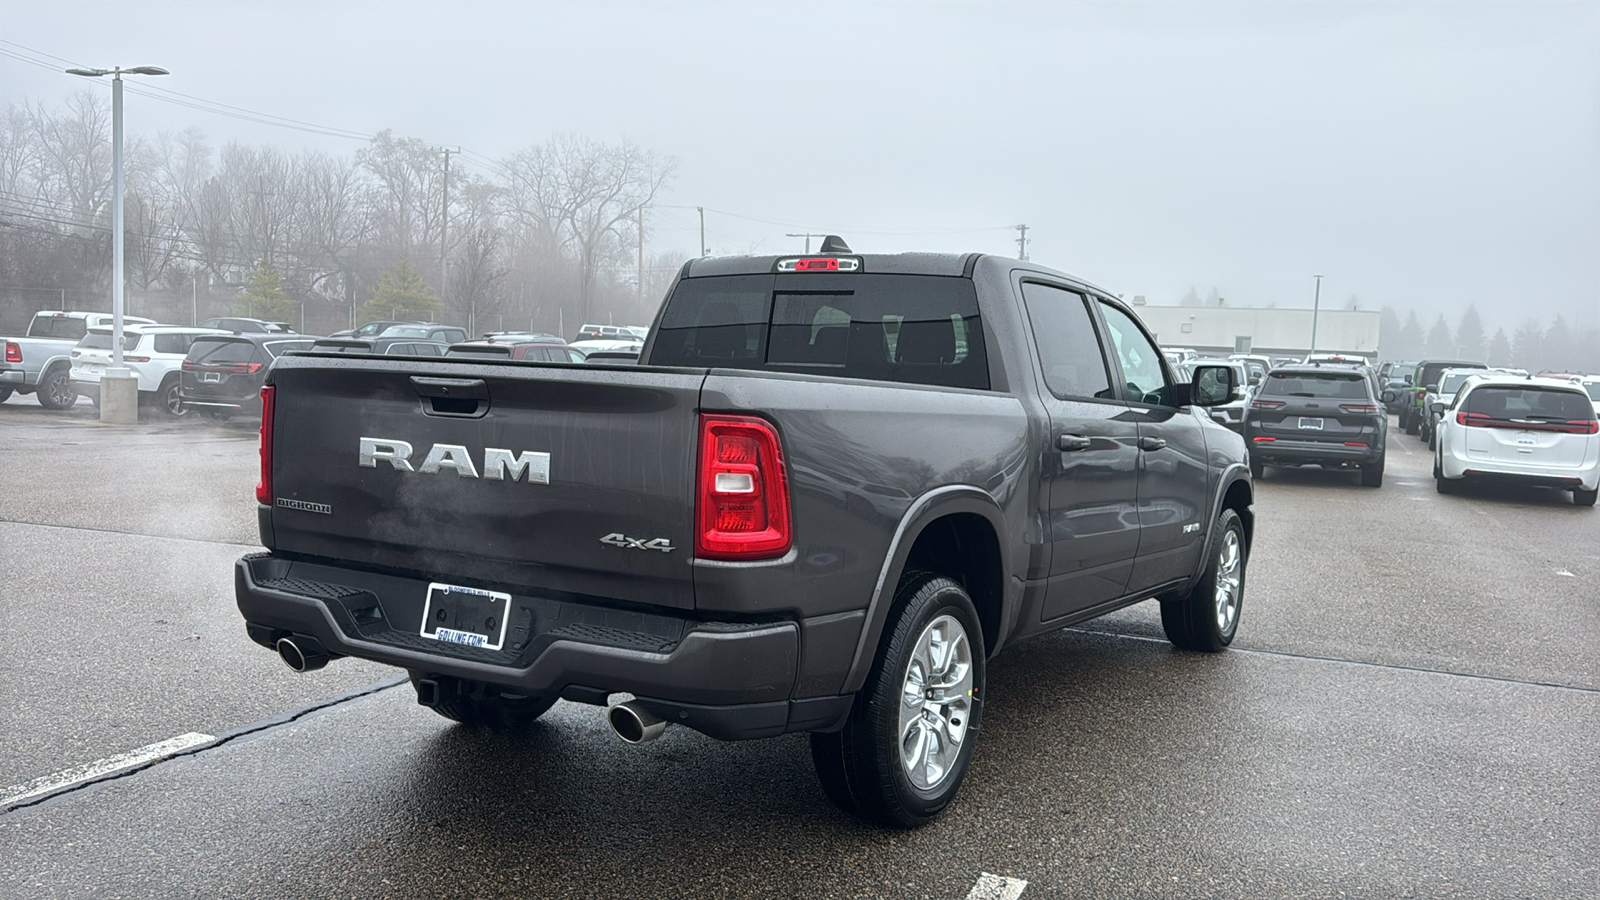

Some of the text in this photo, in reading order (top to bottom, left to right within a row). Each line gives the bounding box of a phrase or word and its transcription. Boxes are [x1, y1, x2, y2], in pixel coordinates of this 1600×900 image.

[358, 436, 551, 485] RAM
[276, 498, 332, 514] BIGHORN
[438, 630, 483, 647] GOLLING.COM
